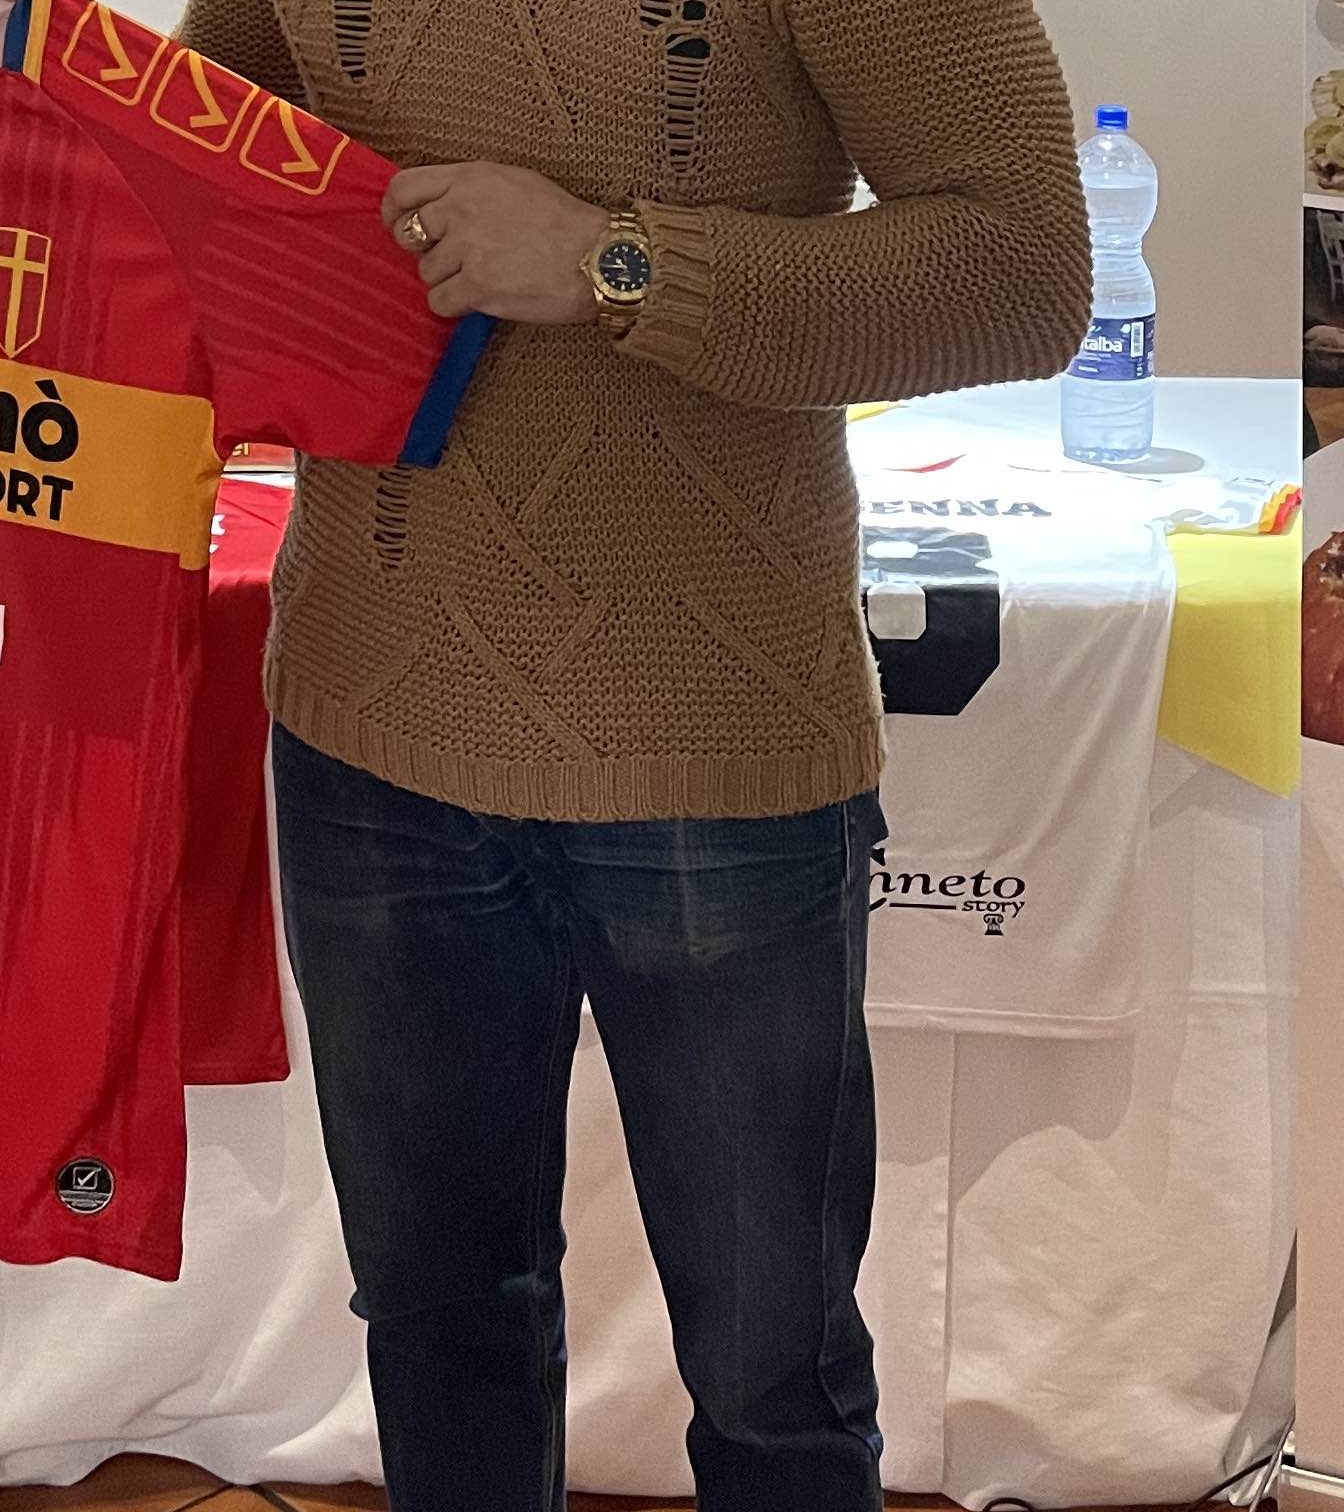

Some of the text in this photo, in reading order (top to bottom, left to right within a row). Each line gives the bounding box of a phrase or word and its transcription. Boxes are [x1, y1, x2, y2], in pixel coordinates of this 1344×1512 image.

[1081, 335, 1123, 353] talba
[860, 499, 1053, 518] ENNA
[870, 848, 1026, 912] nneto
[961, 900, 1025, 918] story
